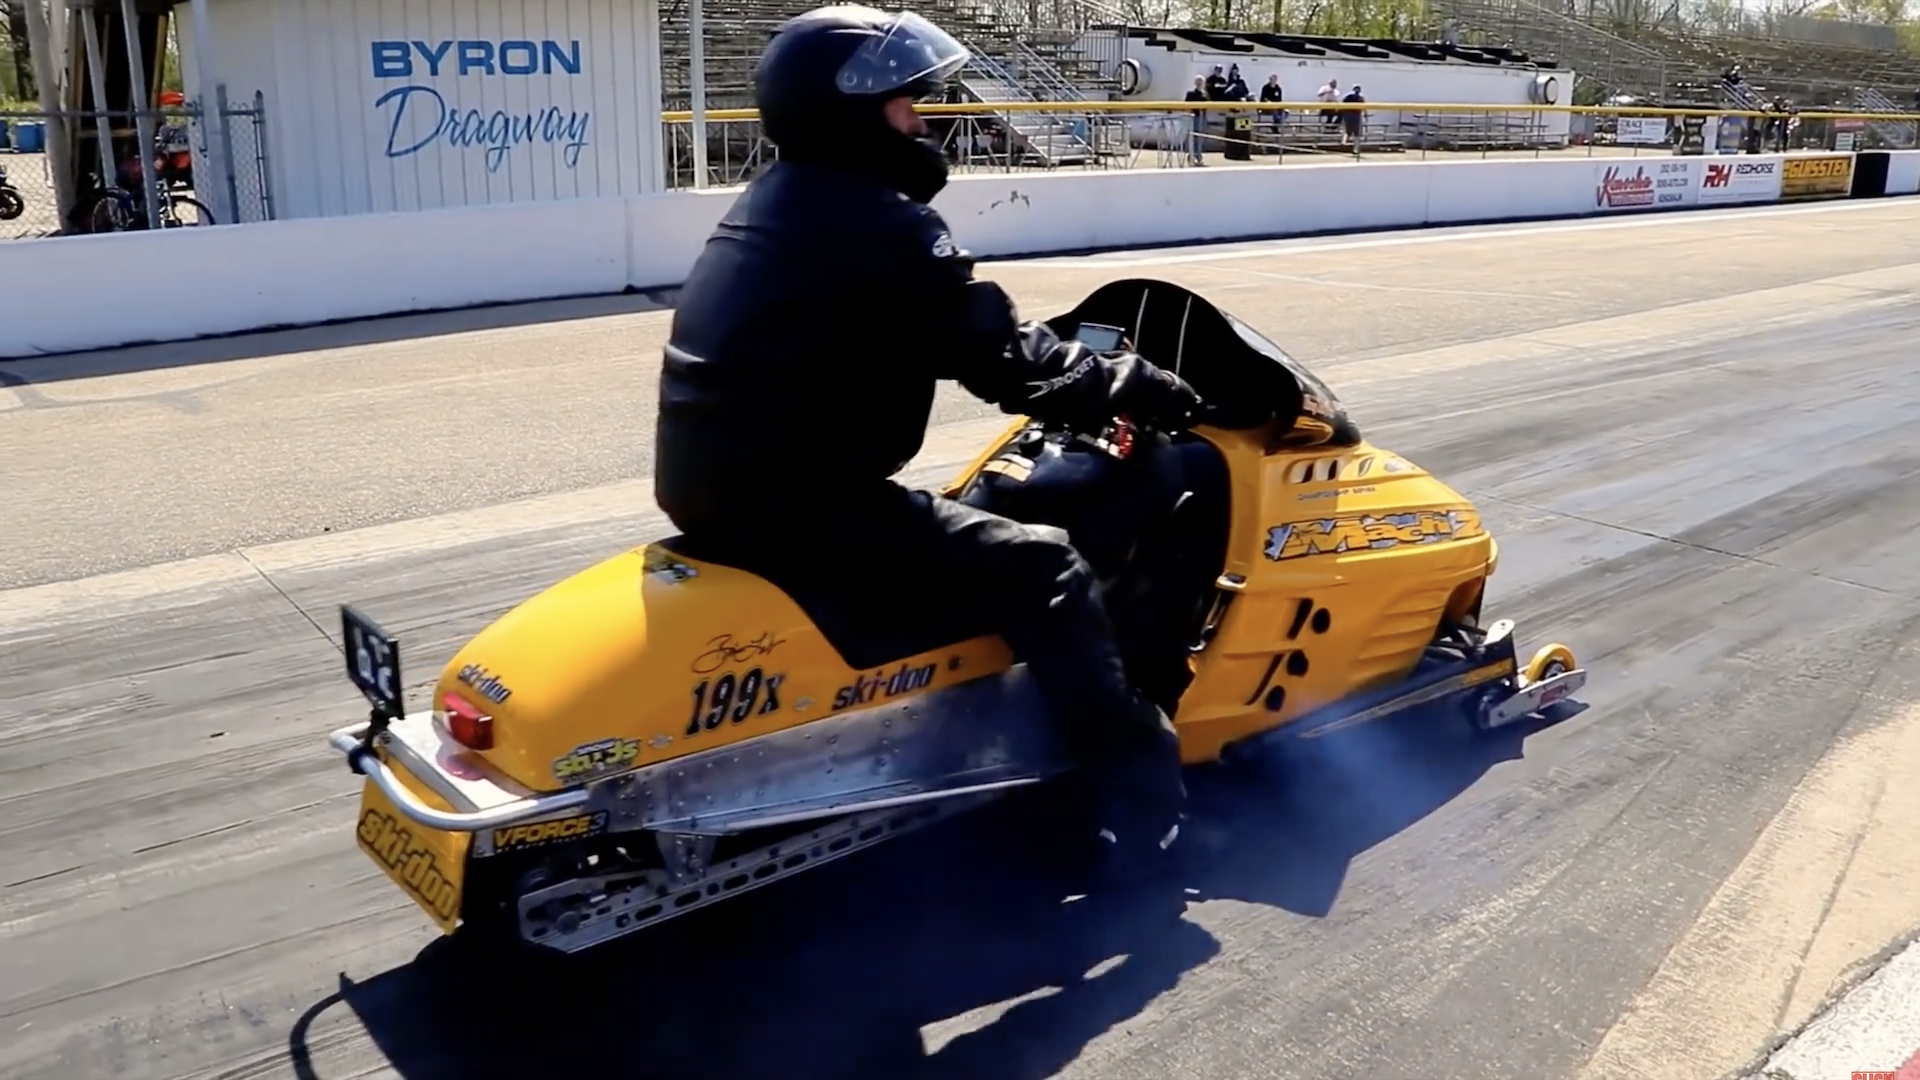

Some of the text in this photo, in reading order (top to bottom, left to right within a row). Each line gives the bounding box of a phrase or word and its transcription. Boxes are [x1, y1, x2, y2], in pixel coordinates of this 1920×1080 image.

[371, 40, 582, 78] BYRON
[375, 85, 590, 174] Dragway
[831, 662, 938, 712] ski-doo
[356, 807, 459, 923] ski-doo
